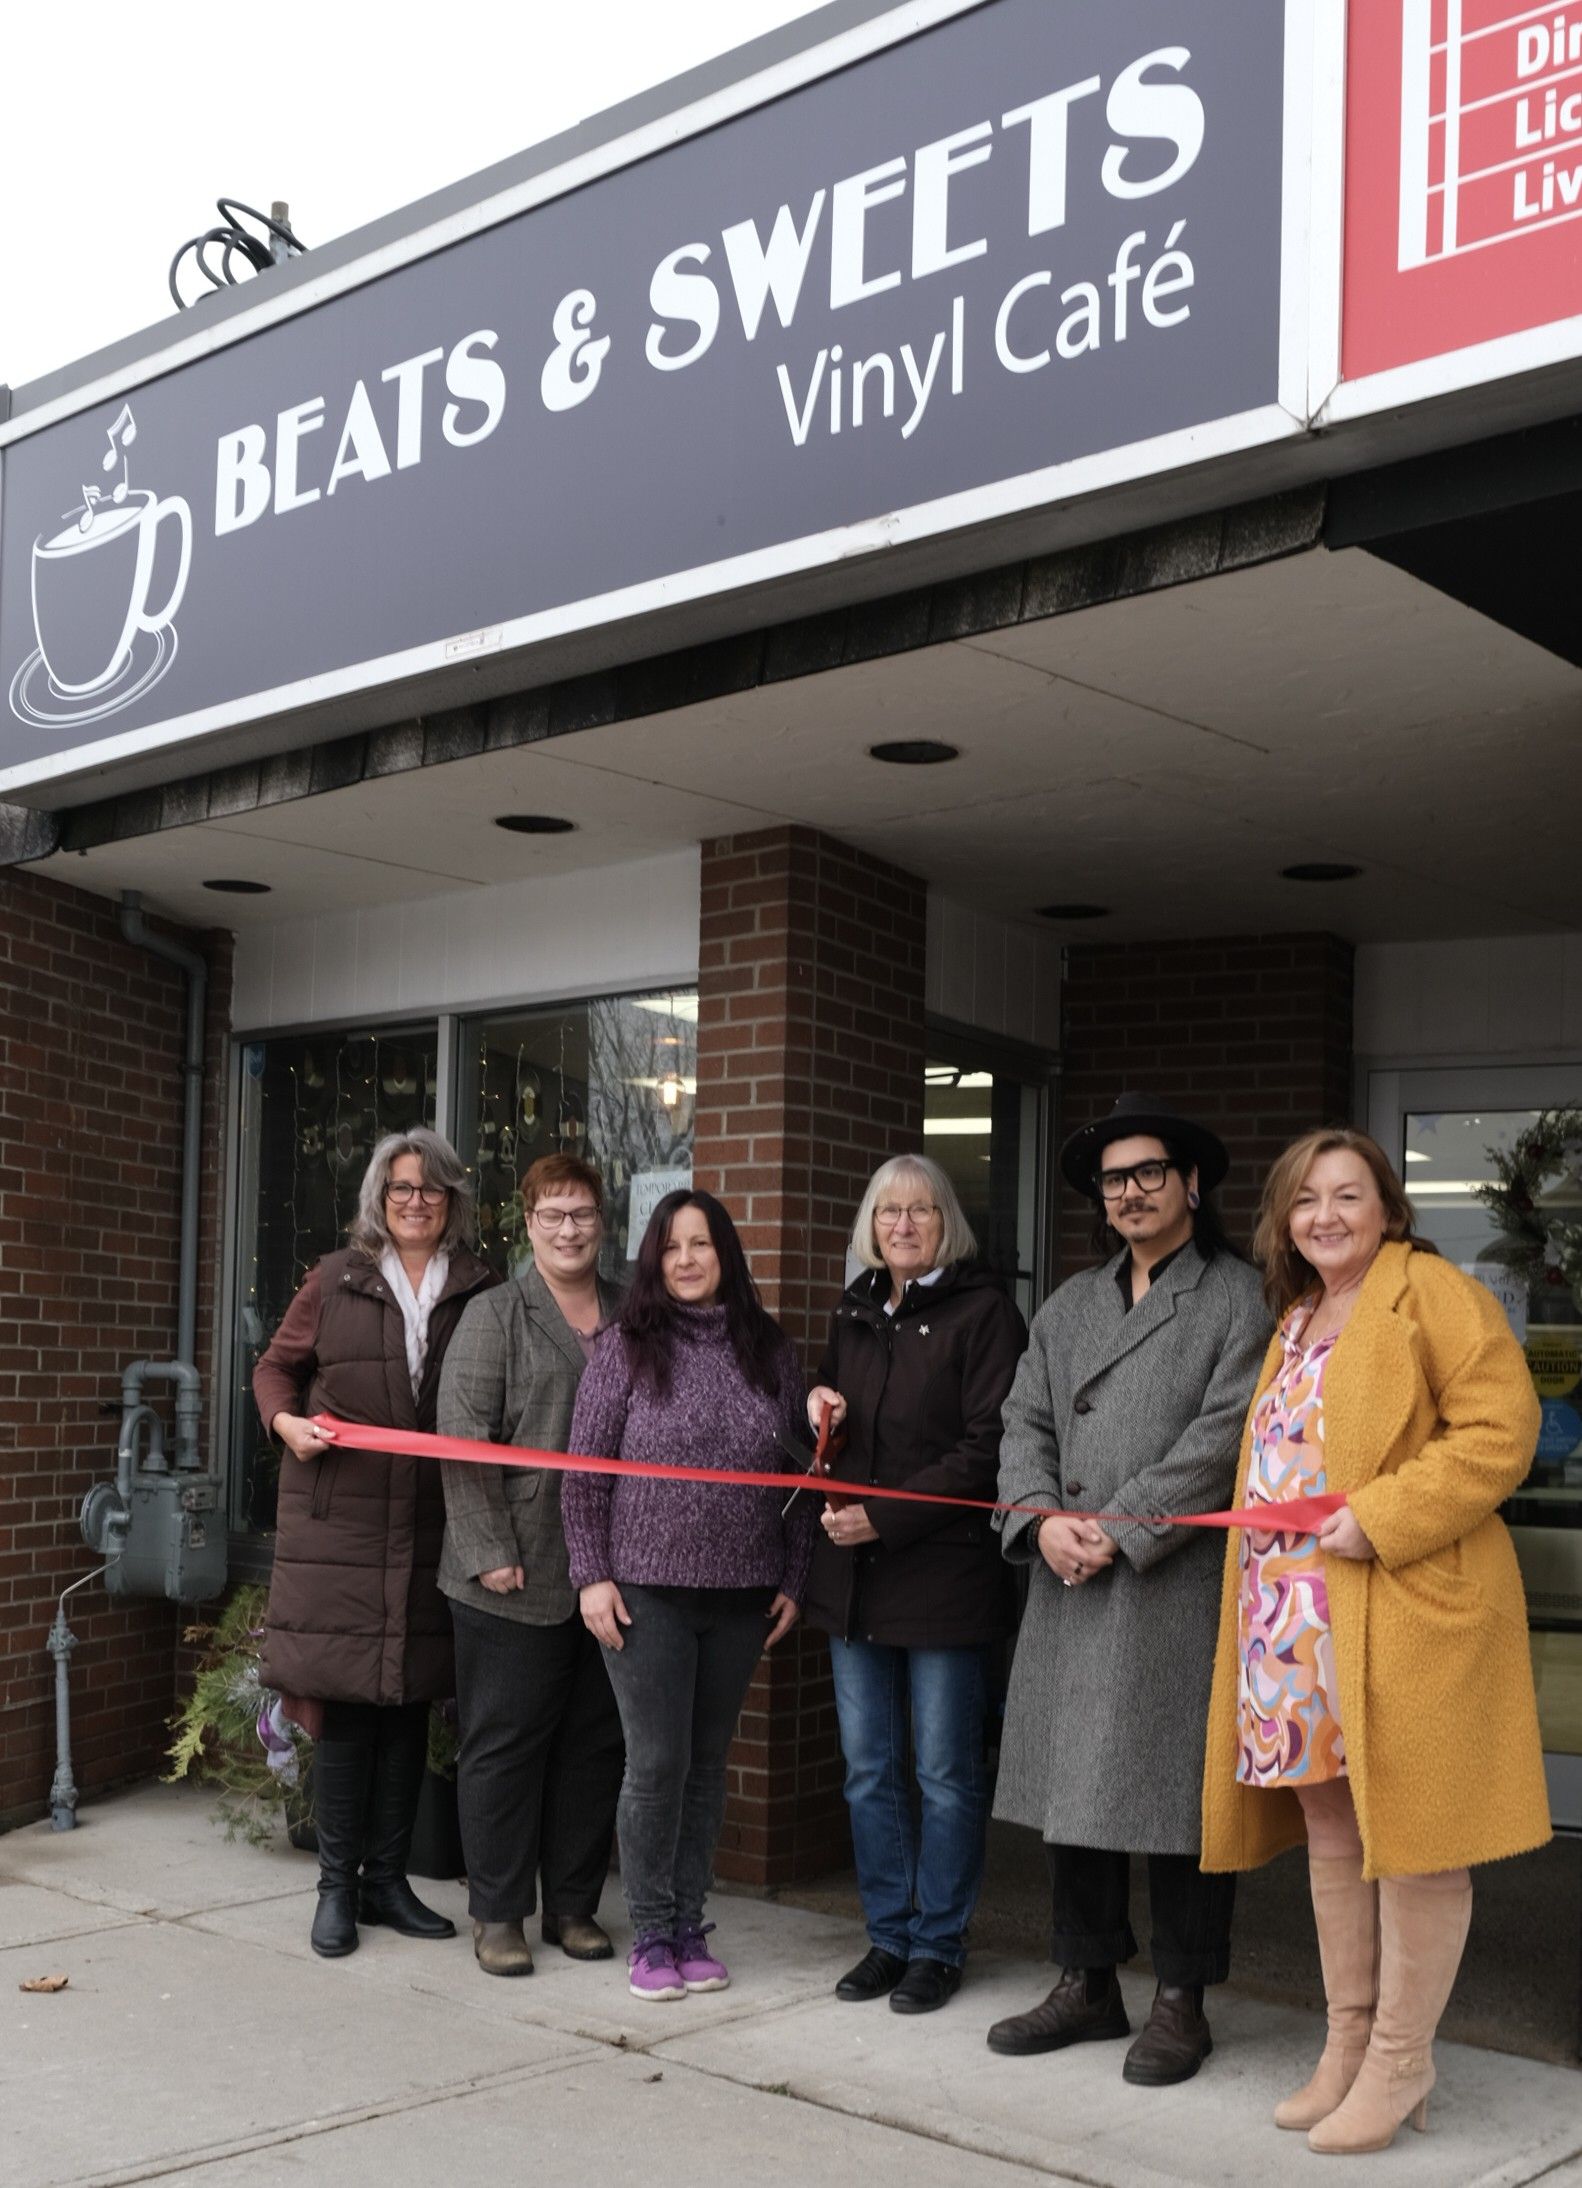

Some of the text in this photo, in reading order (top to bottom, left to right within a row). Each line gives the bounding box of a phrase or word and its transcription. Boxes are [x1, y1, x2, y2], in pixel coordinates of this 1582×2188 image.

[214, 46, 1205, 537] BEATS & SWEETS
[776, 218, 1195, 447] Vinyl Café
[1528, 1350, 1578, 1359] AUTOMATIC
[1529, 1360, 1580, 1374] AUTION
